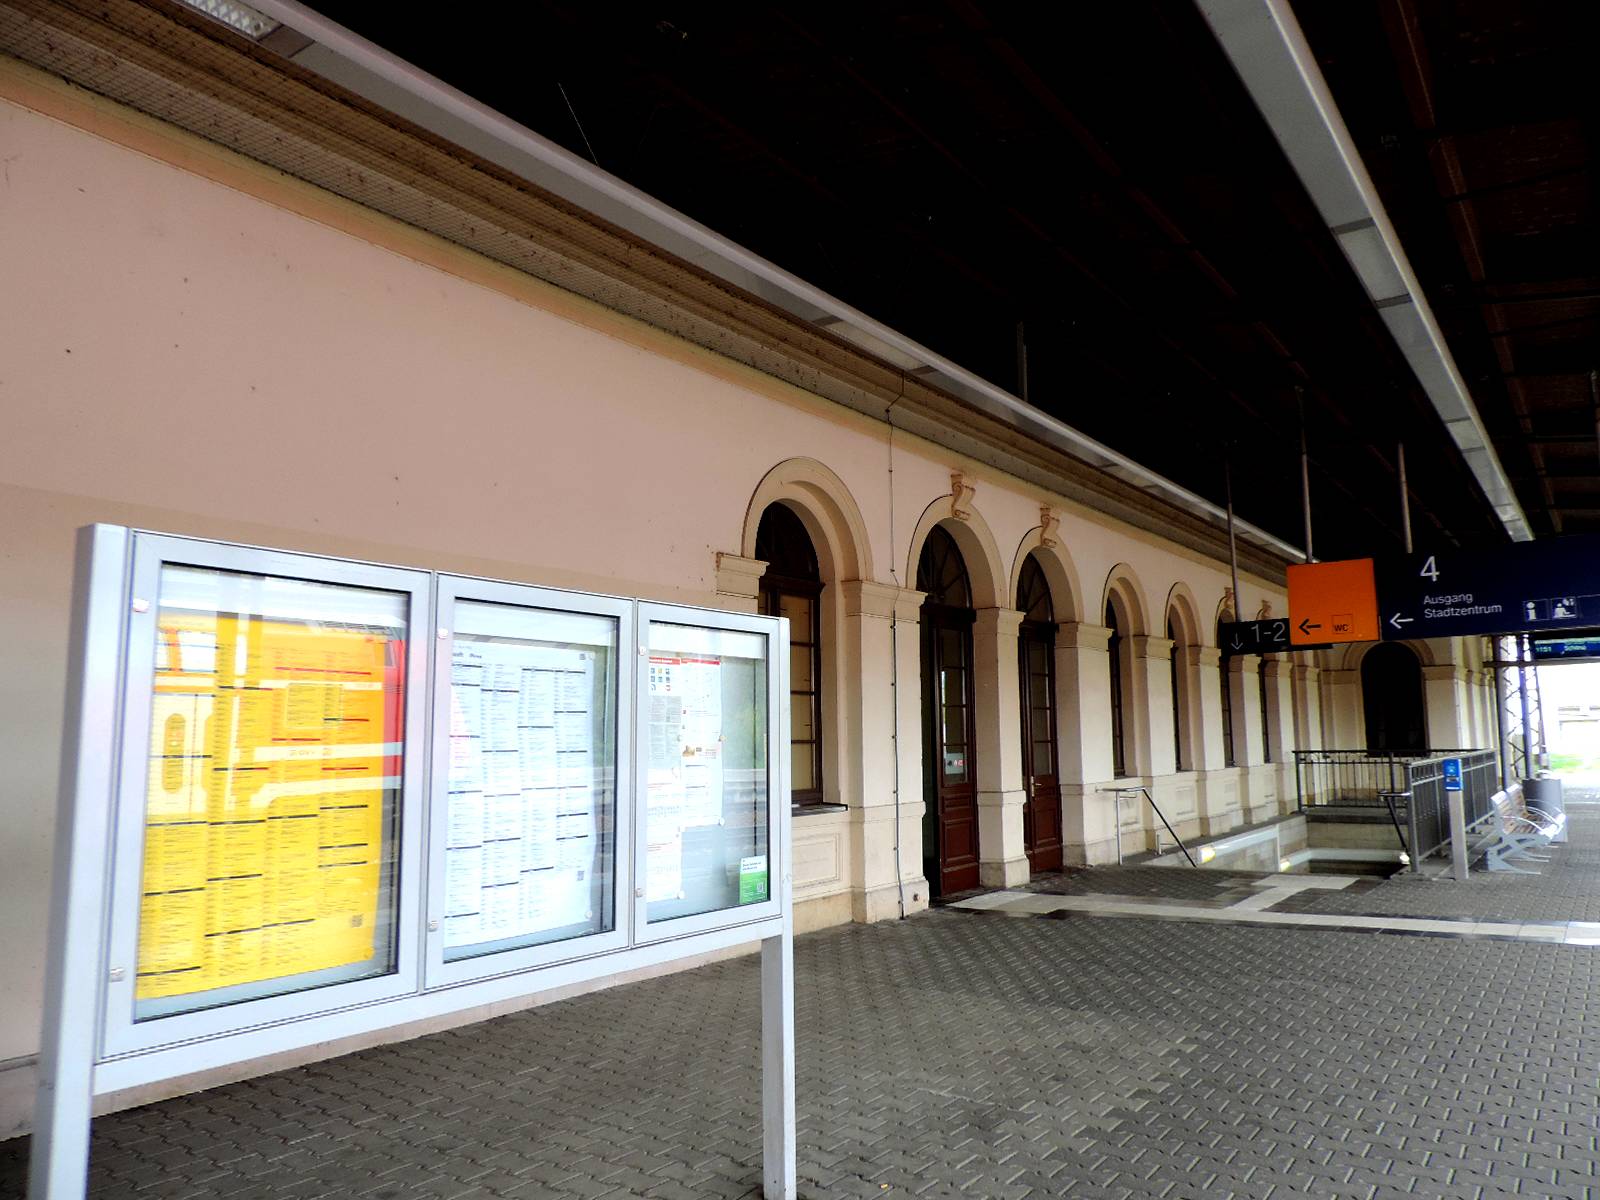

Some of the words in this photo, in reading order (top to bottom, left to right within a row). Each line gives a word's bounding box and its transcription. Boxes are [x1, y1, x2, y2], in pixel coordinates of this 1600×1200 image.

[1420, 555, 1440, 582] 4
[1424, 593, 1473, 605] Ausgang
[1424, 604, 1503, 618] Stadtzentrum
[1251, 621, 1286, 643] 1-2
[1334, 623, 1348, 632] WC
